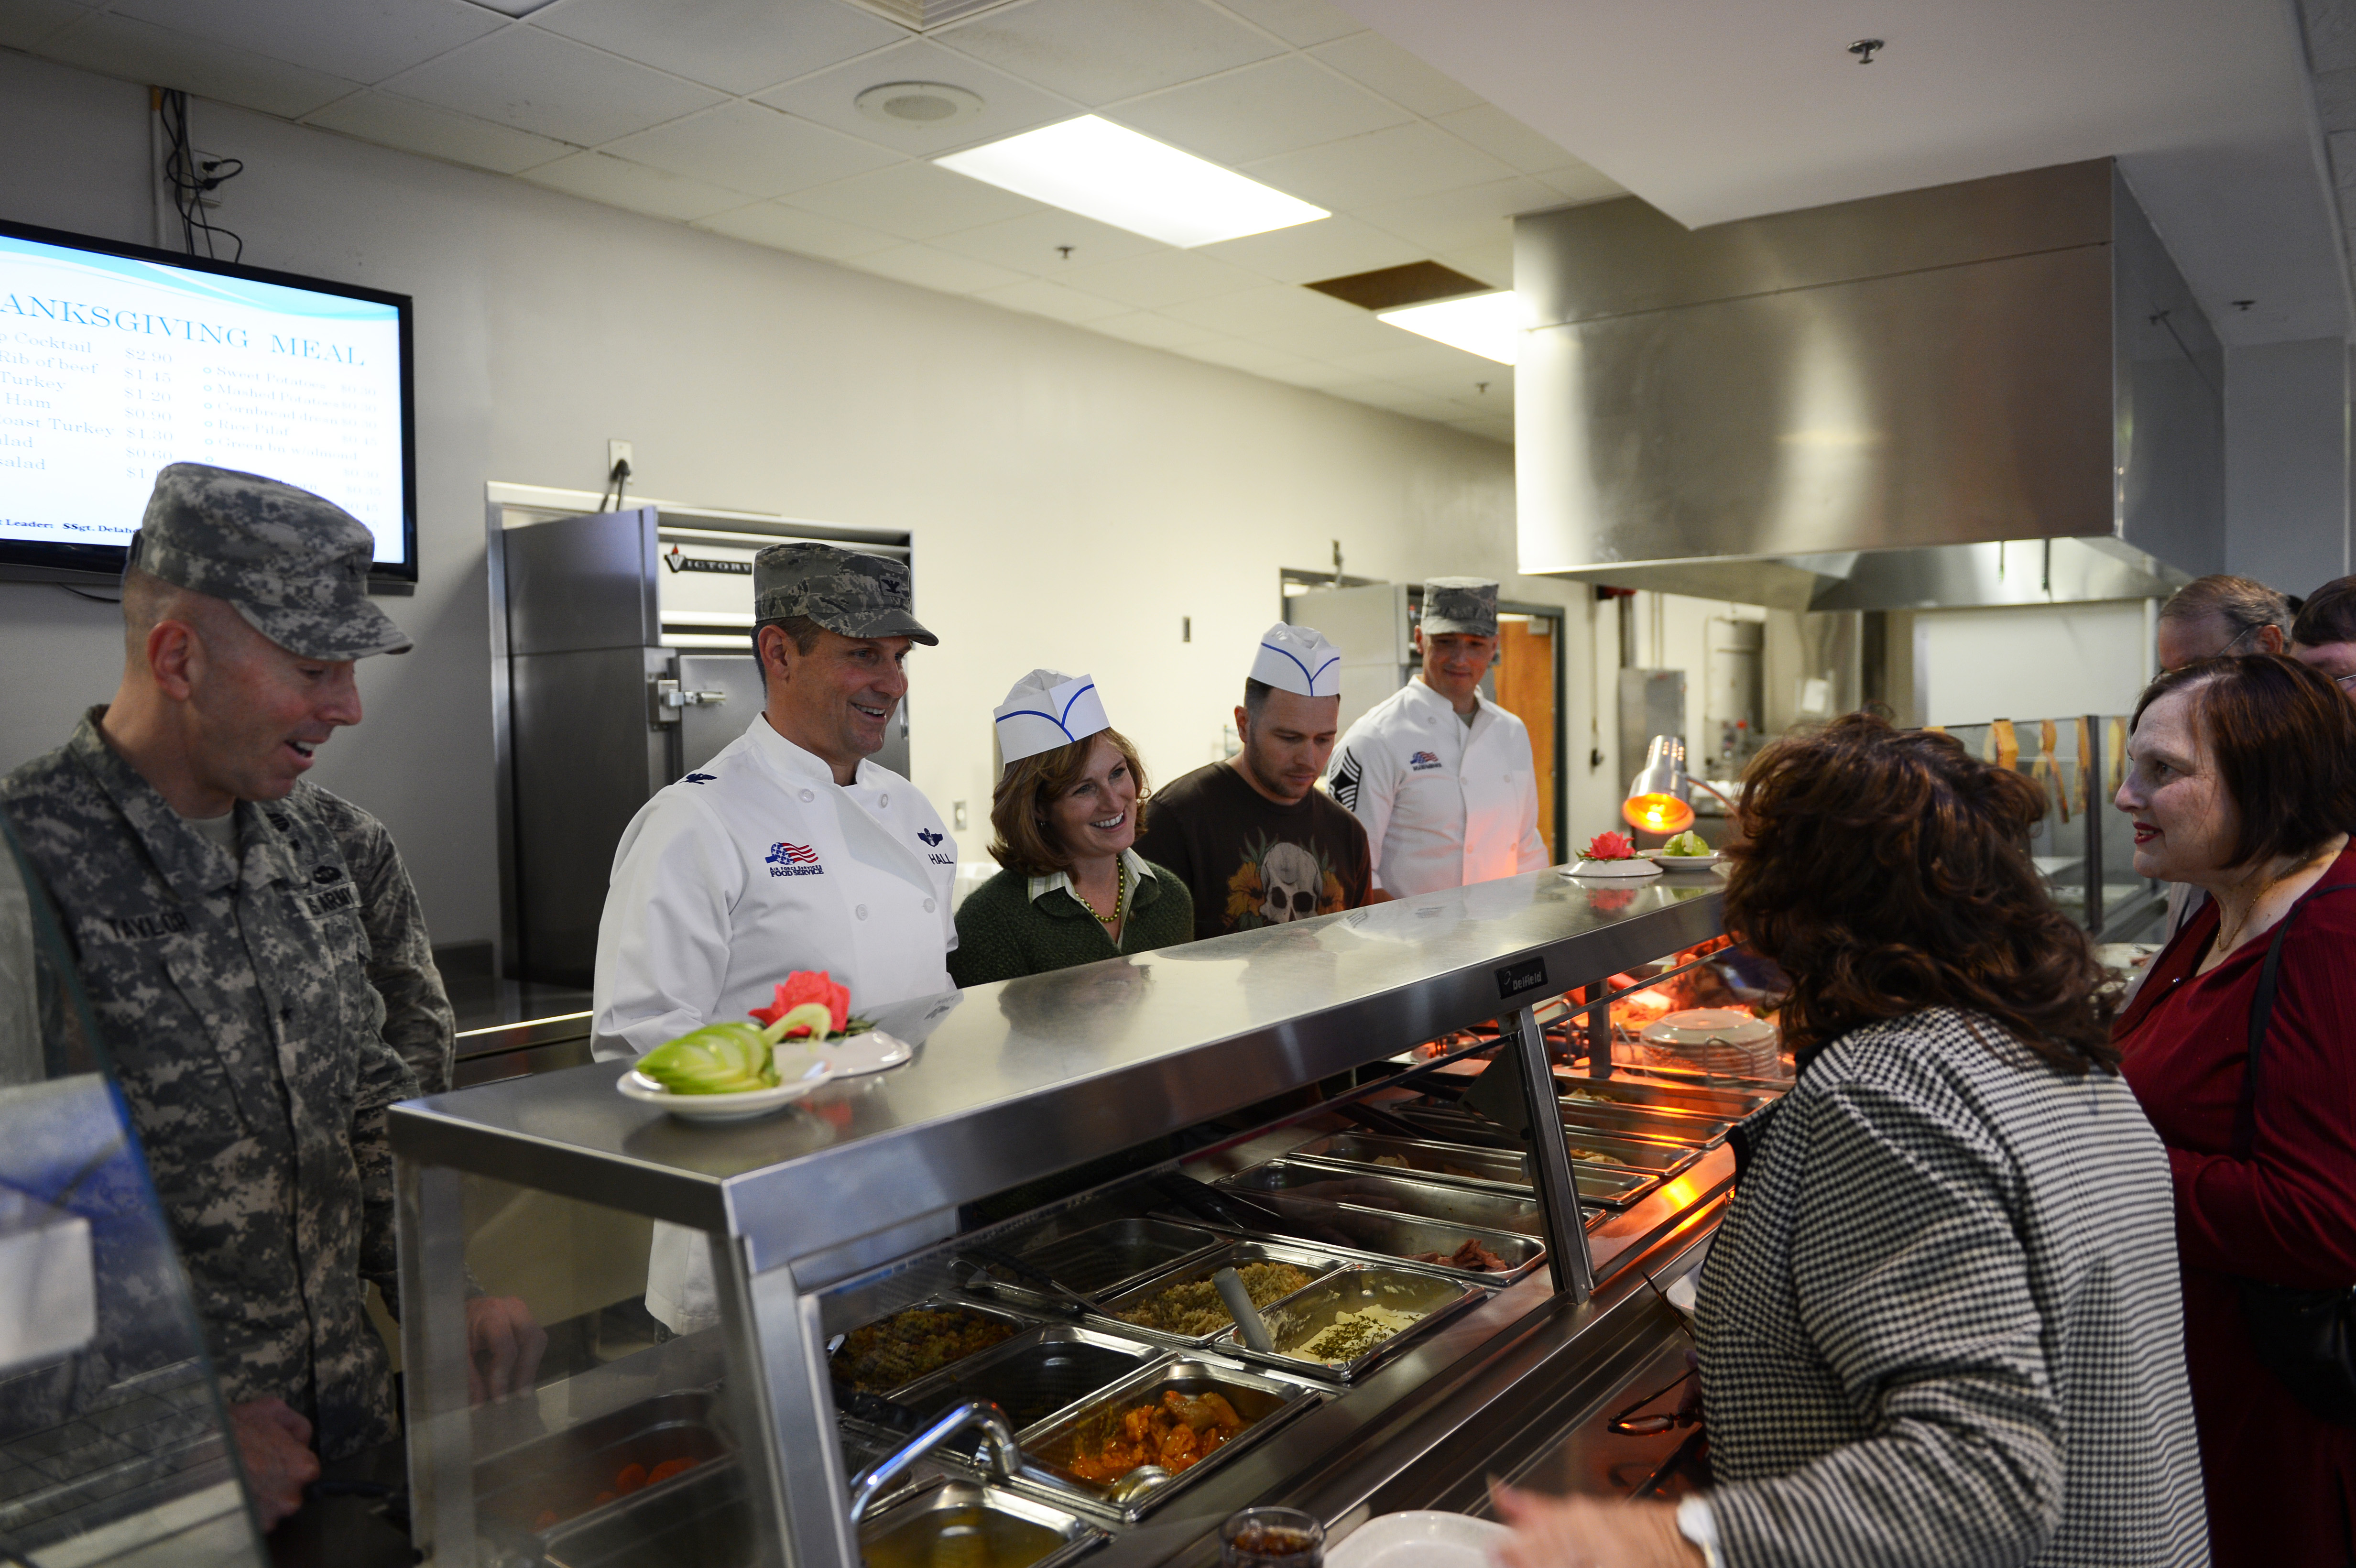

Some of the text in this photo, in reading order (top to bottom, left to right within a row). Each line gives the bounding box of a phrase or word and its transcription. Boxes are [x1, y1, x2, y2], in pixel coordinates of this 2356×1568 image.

[15, 332, 92, 353] Cocktail
[270, 333, 365, 366] MEAL
[0, 350, 99, 374] Rib of beef
[125, 348, 172, 364] $2.90
[0, 371, 66, 392] Turkey
[217, 367, 326, 390] Sweet Potatoes
[5, 392, 51, 409] Ham
[218, 382, 276, 400] Mashed
[218, 402, 295, 420] Cornbread
[0, 415, 115, 437] oast Turkey
[219, 419, 250, 430] Rice
[6, 519, 54, 528] Leader:
[63, 523, 95, 532] SSgt.
[666, 554, 752, 572] VICTORY
[928, 853, 954, 865] HALL
[317, 887, 355, 912] ARMY
[1512, 971, 1542, 991] Delfield
